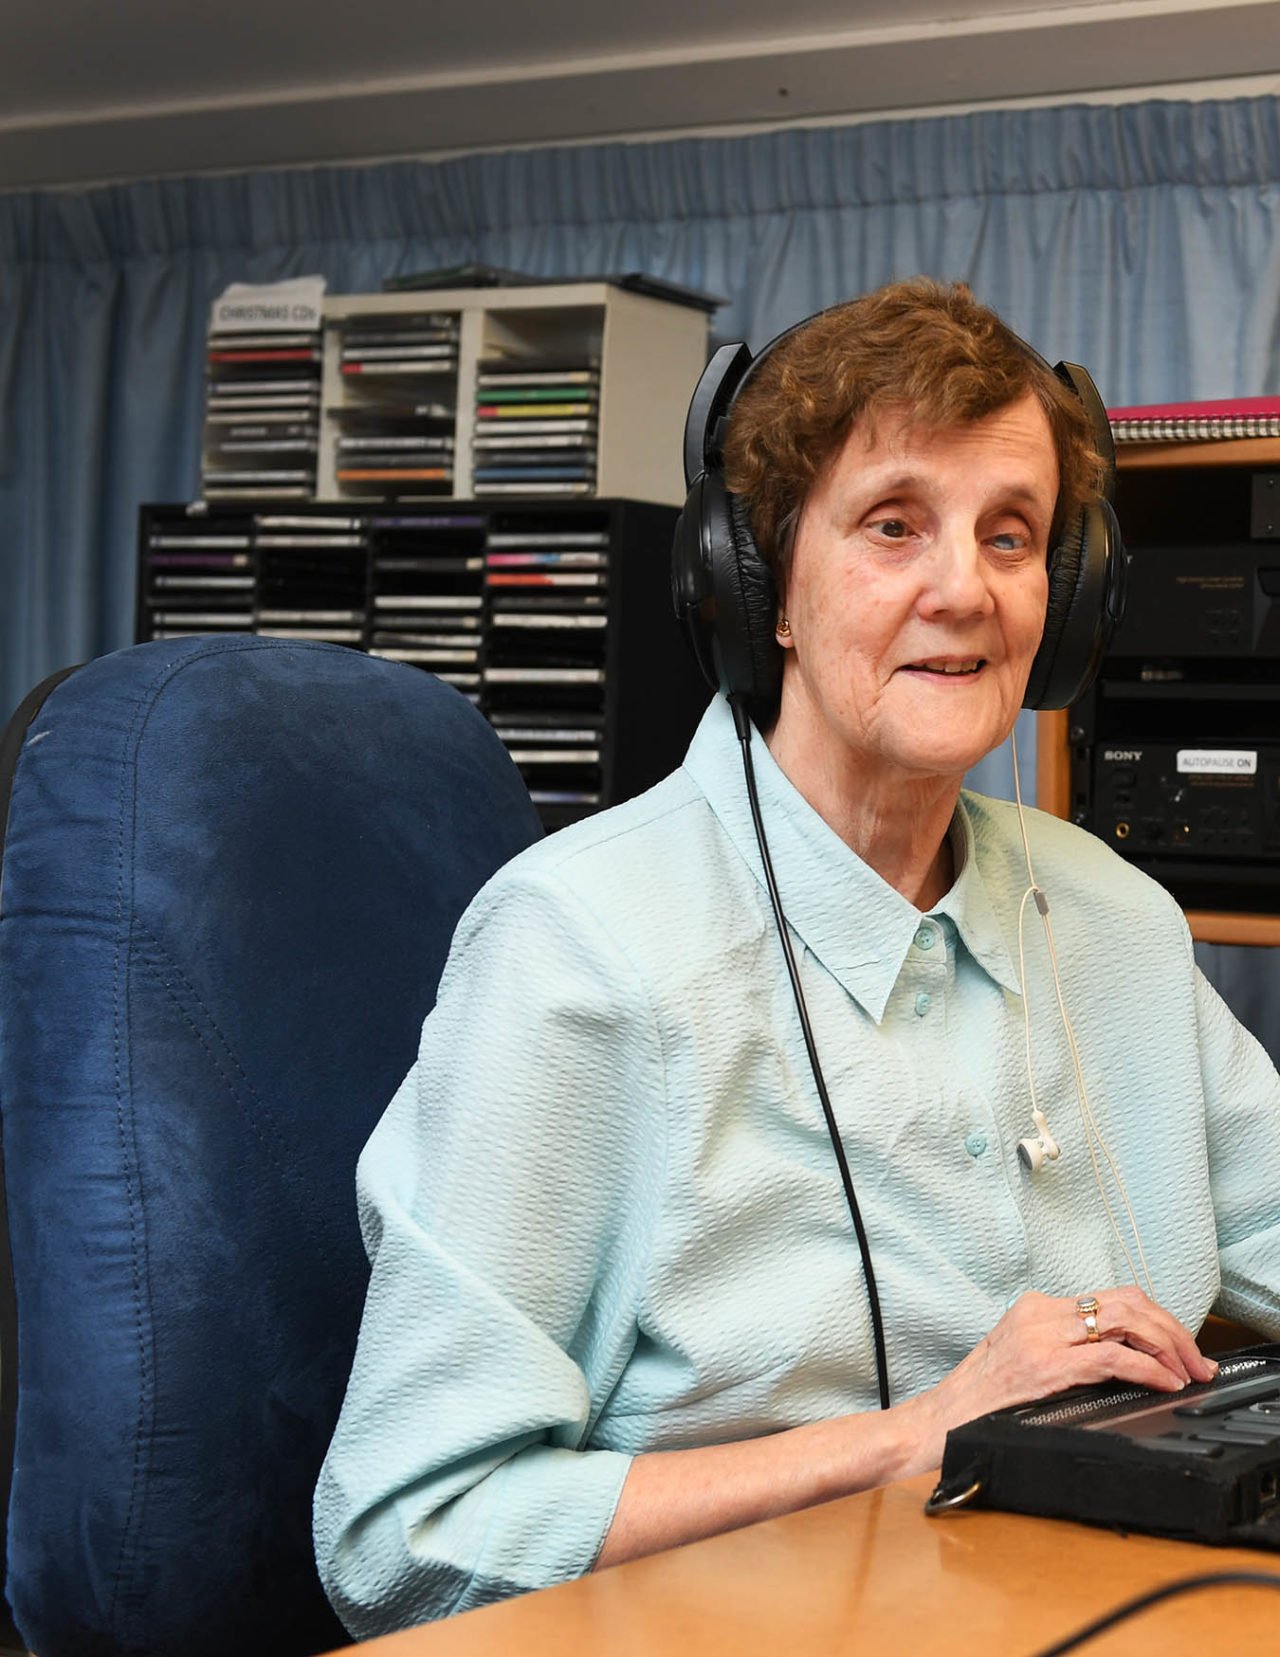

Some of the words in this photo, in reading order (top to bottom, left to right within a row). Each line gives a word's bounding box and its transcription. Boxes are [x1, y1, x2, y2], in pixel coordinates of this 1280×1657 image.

[219, 305, 289, 322] CHRISTMAS
[1104, 750, 1143, 761] SONY
[1182, 757, 1234, 768] AUTOPAUSE
[1237, 759, 1251, 768] ON
